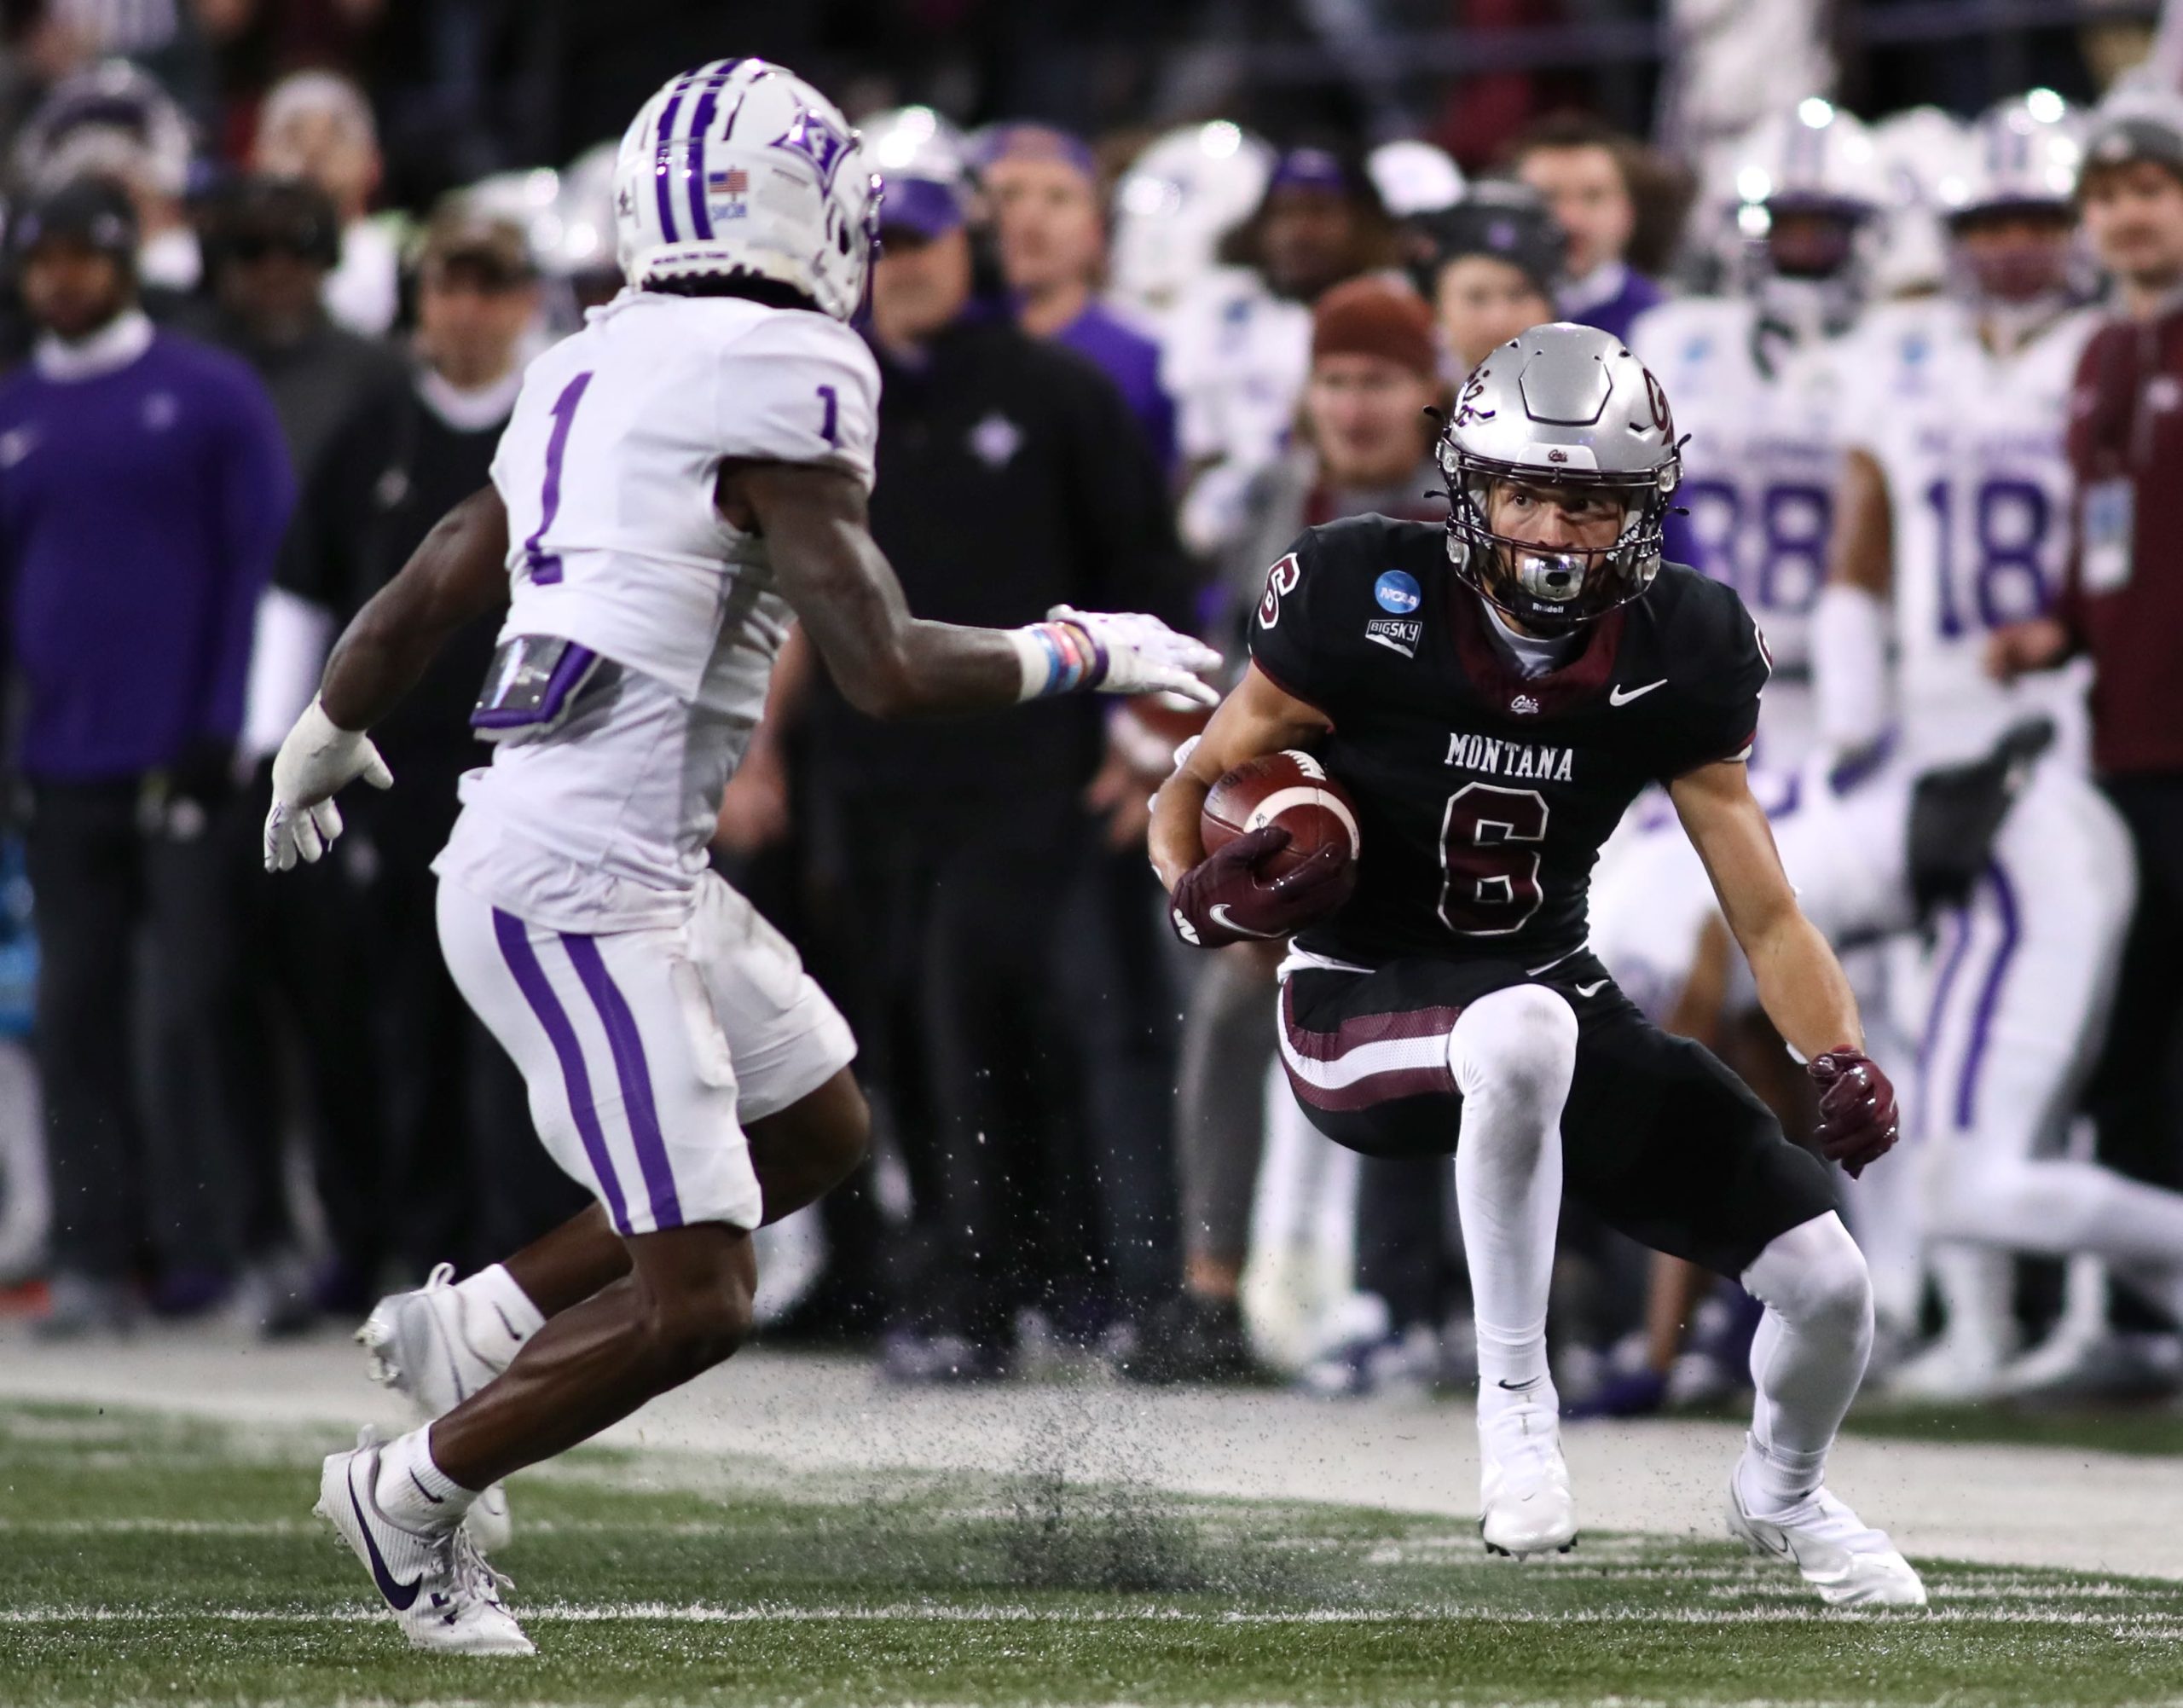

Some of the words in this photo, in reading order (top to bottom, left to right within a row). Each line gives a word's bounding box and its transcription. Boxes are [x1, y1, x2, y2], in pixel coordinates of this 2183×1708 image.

[816, 384, 839, 449] 1
[525, 370, 595, 587] 1
[1258, 552, 1300, 629] 6
[1380, 587, 1418, 607] NCAA
[1925, 478, 2051, 640] 18
[1444, 732, 1573, 782] MONTANA
[1438, 781, 1549, 935] 6
